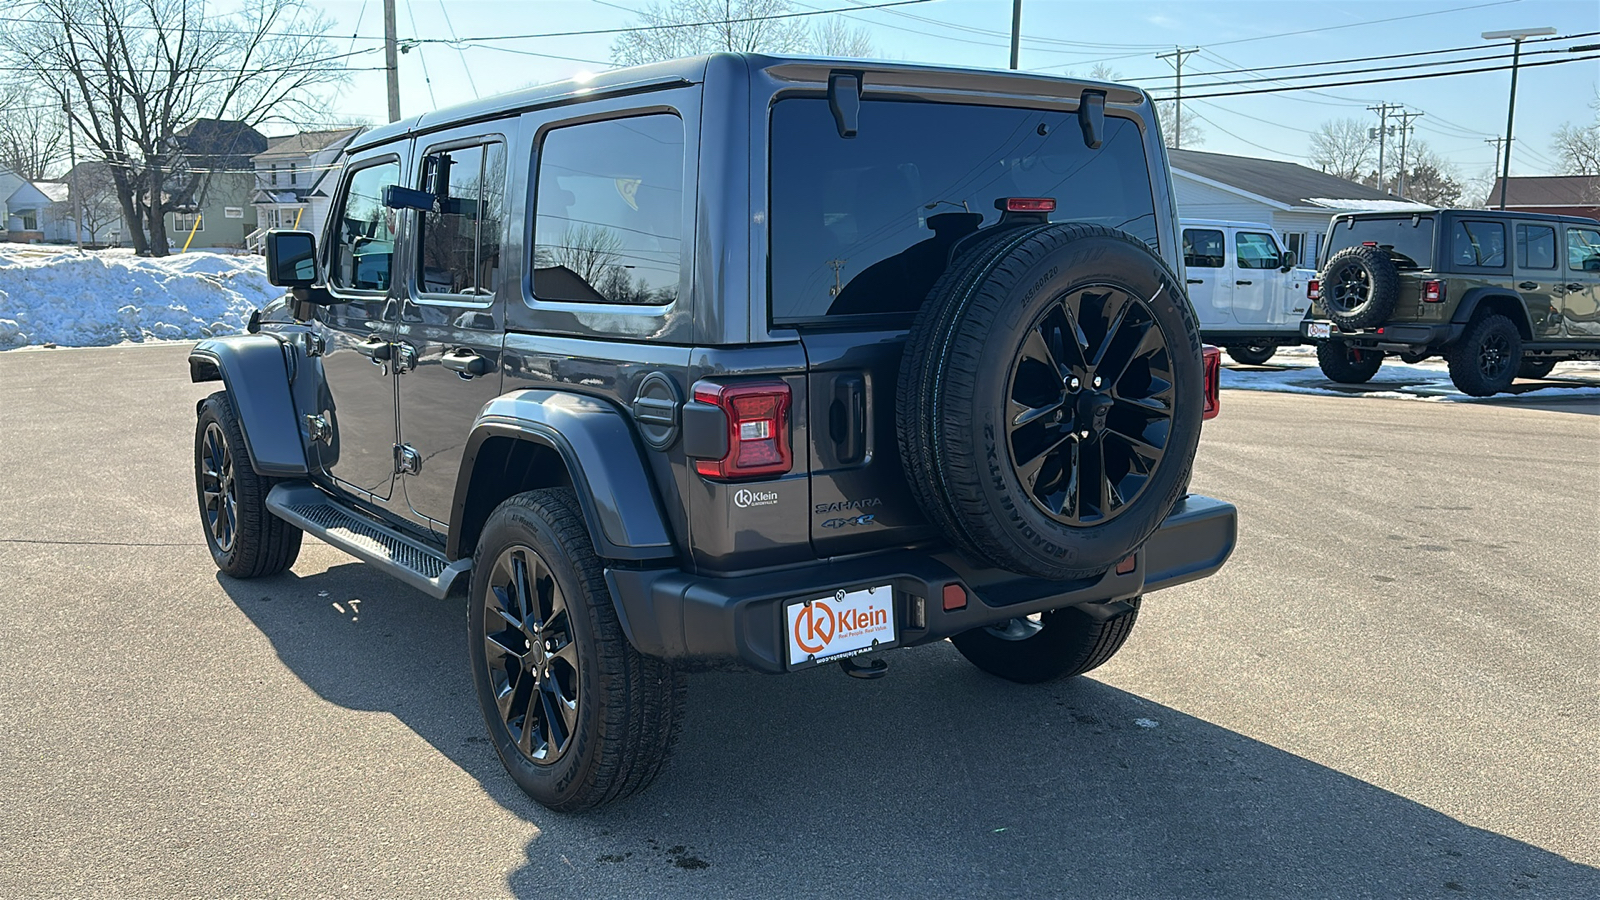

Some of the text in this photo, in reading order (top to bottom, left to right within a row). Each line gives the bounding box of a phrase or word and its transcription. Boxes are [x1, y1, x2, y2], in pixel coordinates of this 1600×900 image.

[1020, 265, 1059, 308] 255/60R20
[1157, 272, 1199, 349] NEXEN
[984, 423, 1006, 492] HTX2
[753, 491, 778, 502] Klein
[815, 497, 882, 514] SAHARA
[838, 605, 887, 633] Klein
